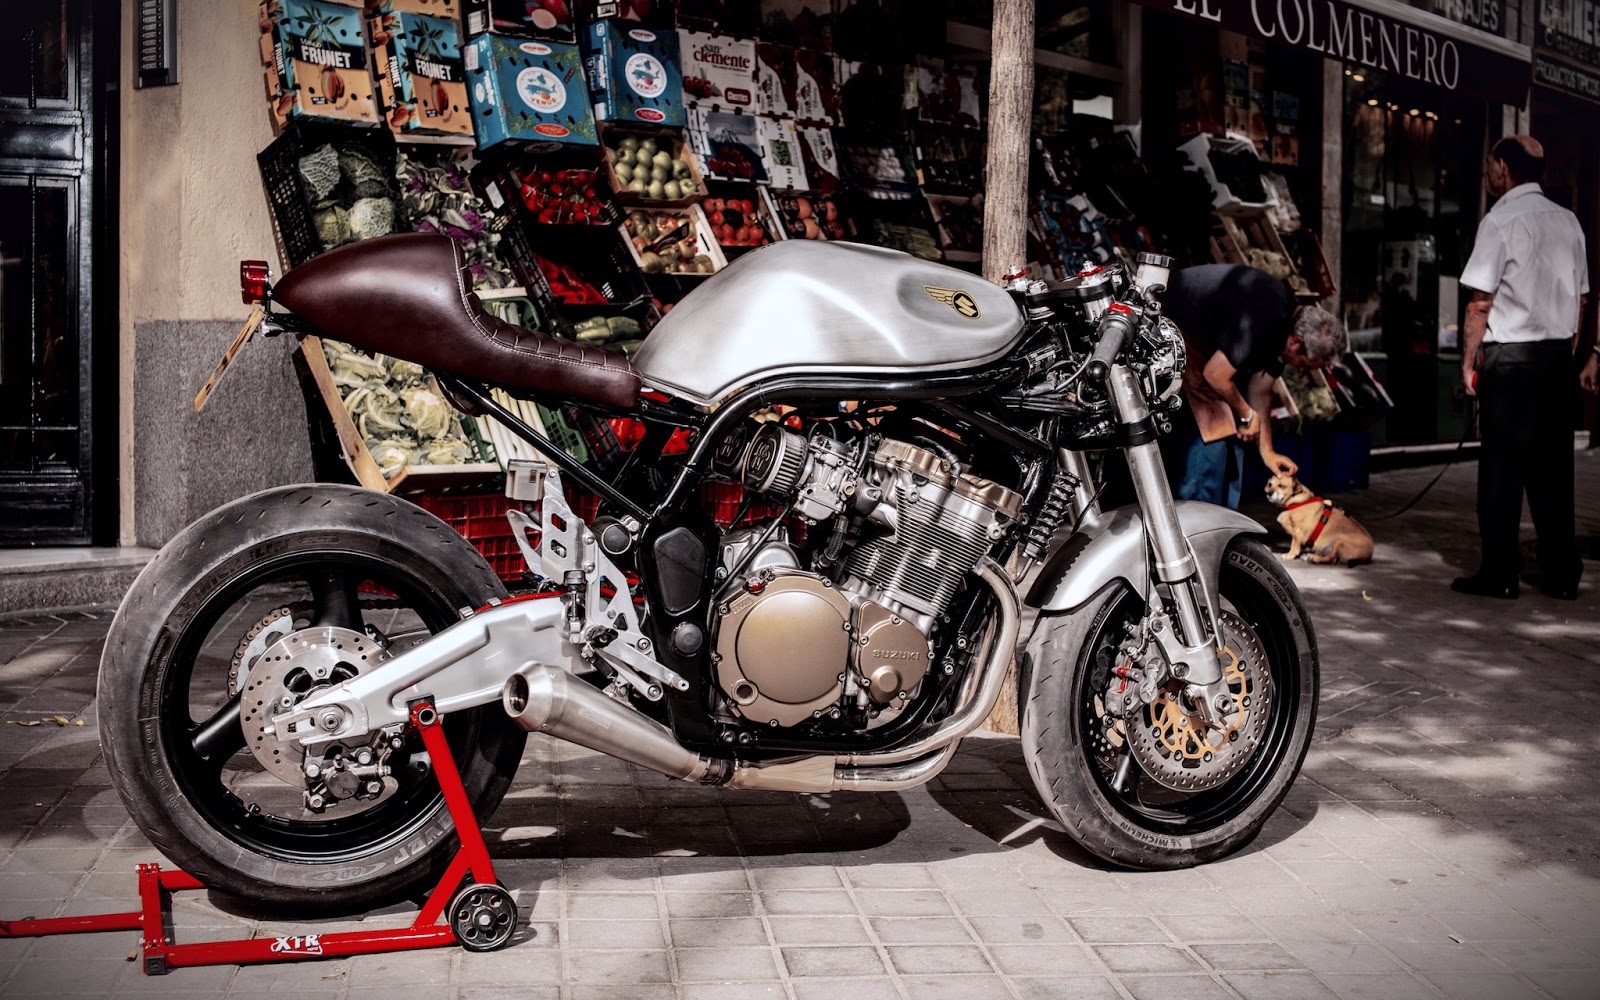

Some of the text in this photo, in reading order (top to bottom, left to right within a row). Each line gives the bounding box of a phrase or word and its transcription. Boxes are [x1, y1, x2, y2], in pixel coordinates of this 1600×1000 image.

[704, 43, 720, 54] san
[1252, 0, 1459, 90] COLMENERO
[274, 42, 285, 76] FRUNET
[301, 45, 351, 69] FRUNET
[693, 47, 751, 69] clemente
[388, 56, 402, 88] FRUNET
[415, 58, 452, 81] FRUNET
[531, 96, 557, 106] VENUS
[872, 649, 921, 661] SUZUKI
[1119, 820, 1169, 848] MICHELIN
[274, 934, 321, 953] XTR
